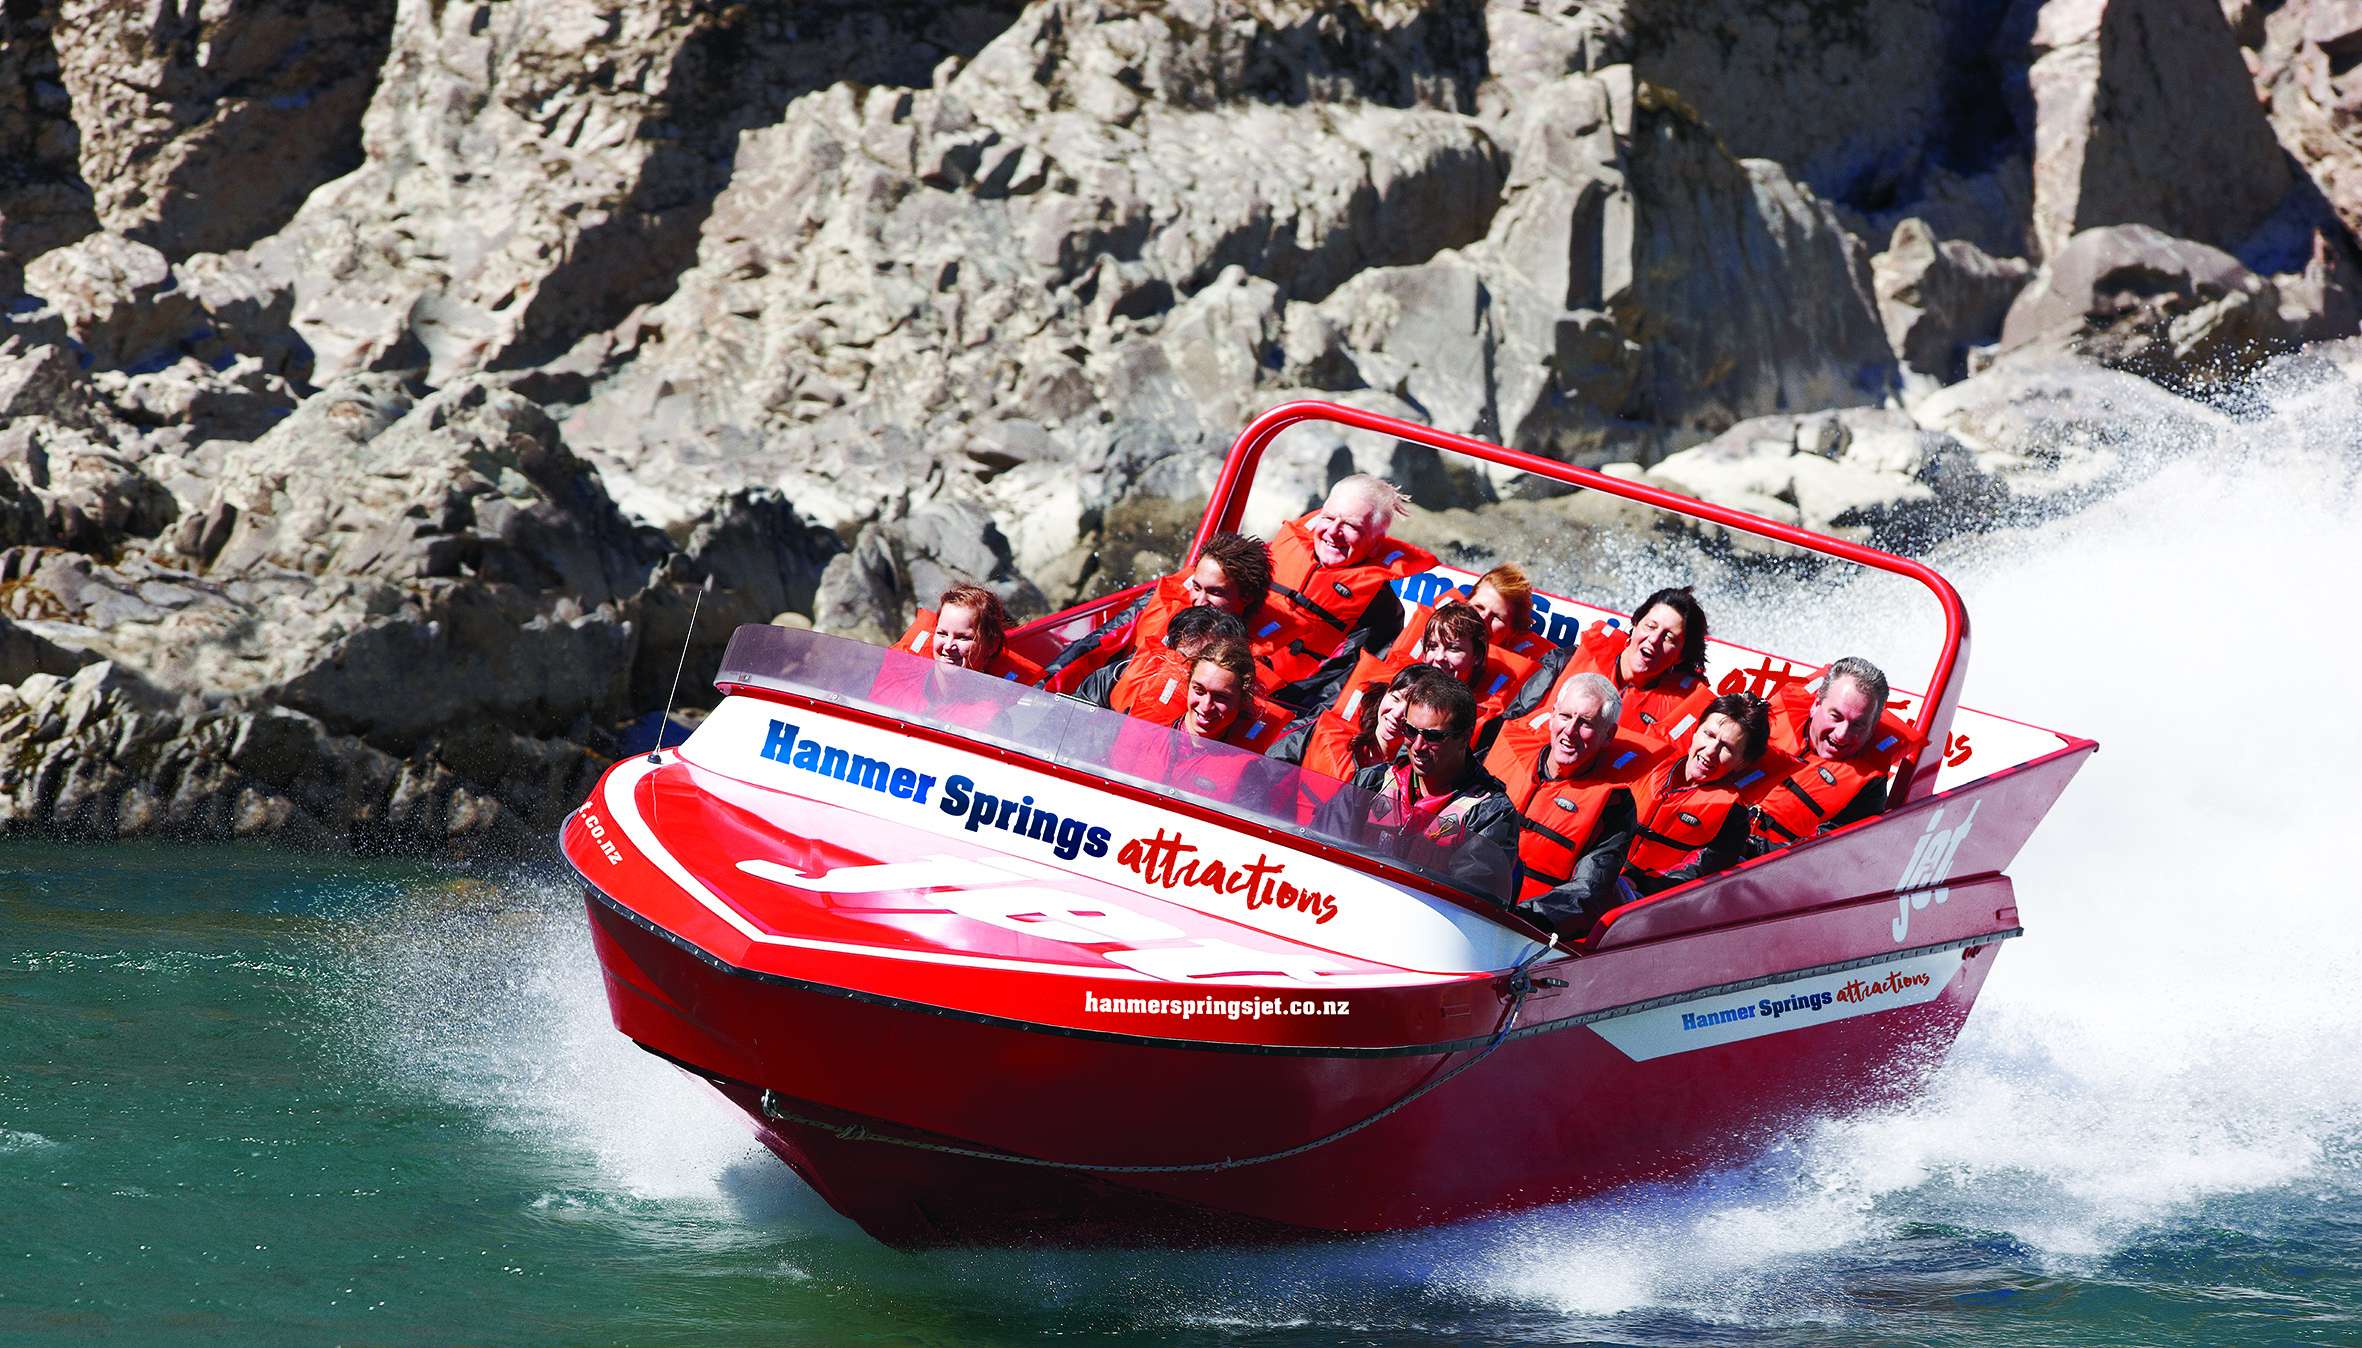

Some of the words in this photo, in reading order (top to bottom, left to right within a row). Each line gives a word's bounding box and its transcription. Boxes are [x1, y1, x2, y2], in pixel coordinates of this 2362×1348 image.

[760, 719, 936, 804] Hanmer
[940, 775, 1112, 860] Springs
[1117, 827, 1338, 924] attractions
[1892, 799, 1982, 943] jet
[1085, 991, 1350, 1020] hanmerspringsjet.co.nz
[1682, 1005, 1756, 1030] Hanmer
[1760, 991, 1833, 1018] Springs
[1837, 971, 1931, 1003] attractions
